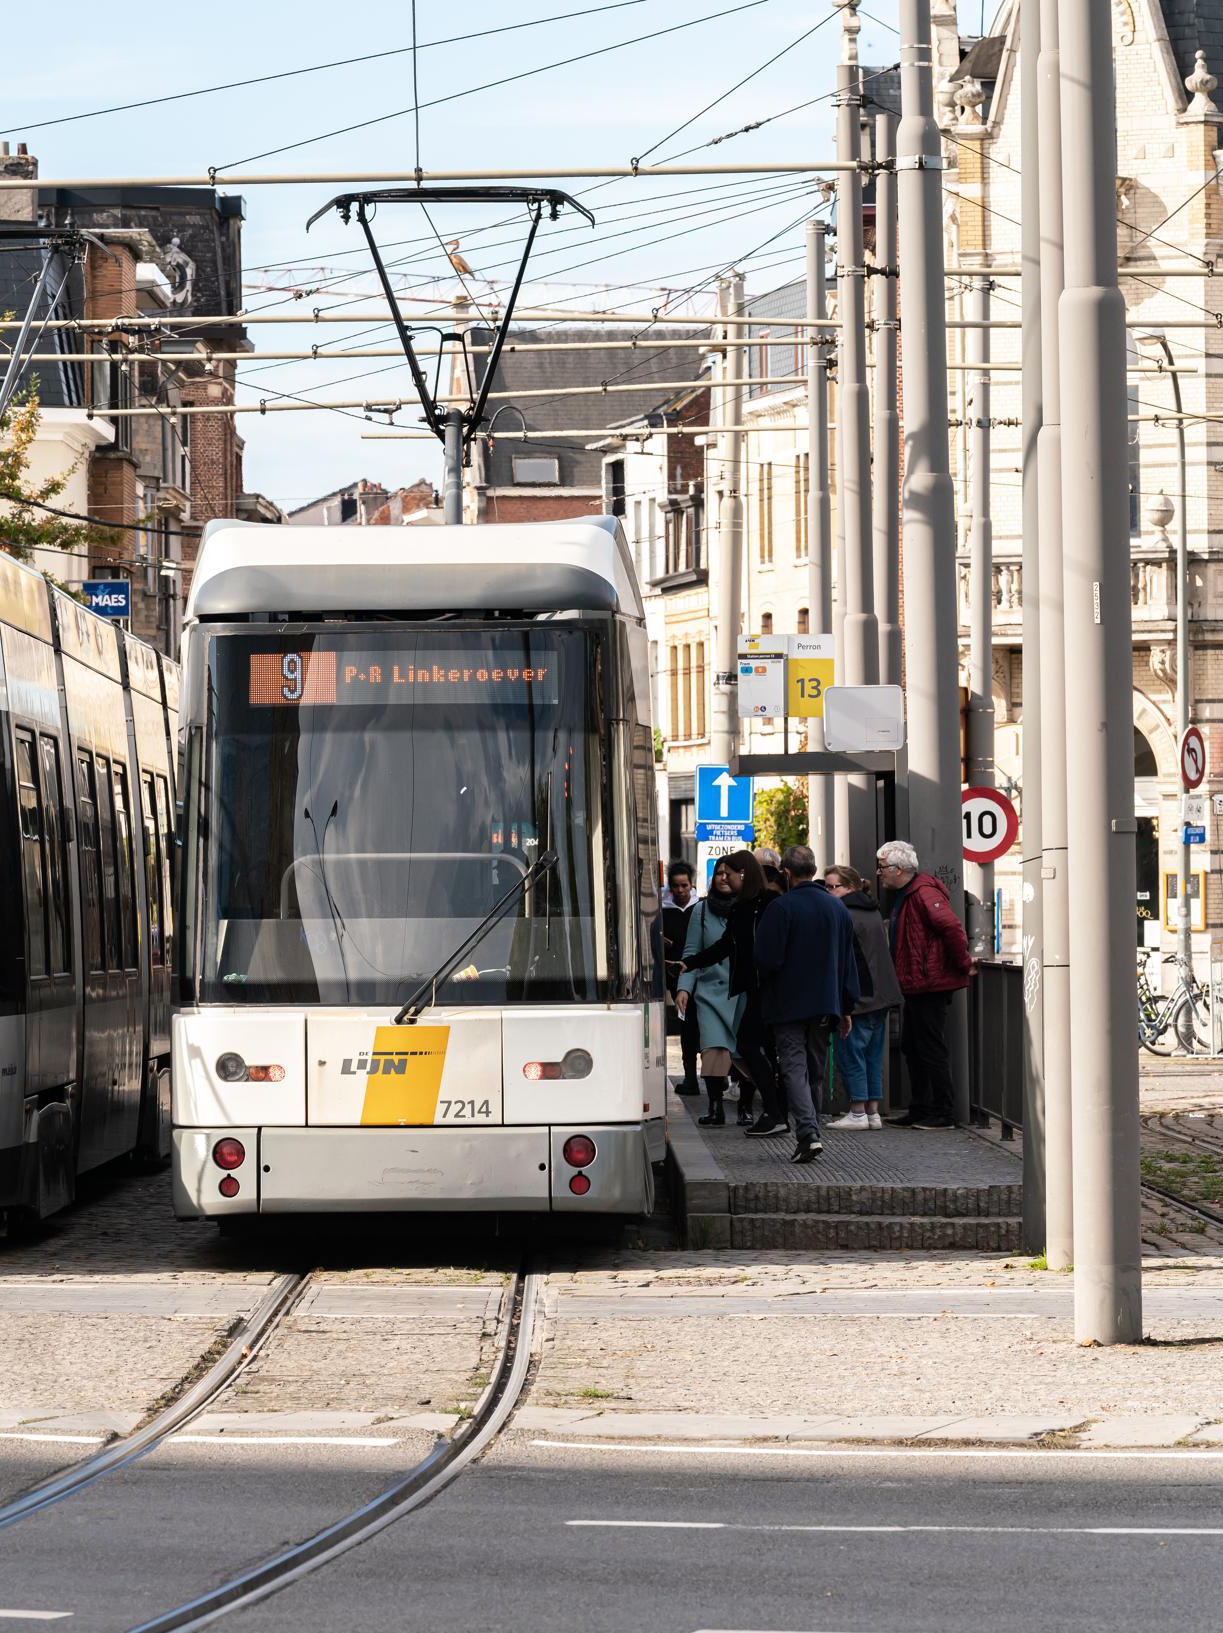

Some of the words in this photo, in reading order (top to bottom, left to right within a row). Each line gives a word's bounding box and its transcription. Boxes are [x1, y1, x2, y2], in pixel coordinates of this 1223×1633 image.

[92, 594, 126, 607] MAES
[797, 642, 822, 650] Perron
[282, 653, 303, 700] 9
[343, 664, 383, 684] P+R
[392, 664, 548, 684] Linkeroever
[796, 678, 822, 699] 13
[963, 810, 998, 840] 10
[439, 1099, 492, 1119] 7214
